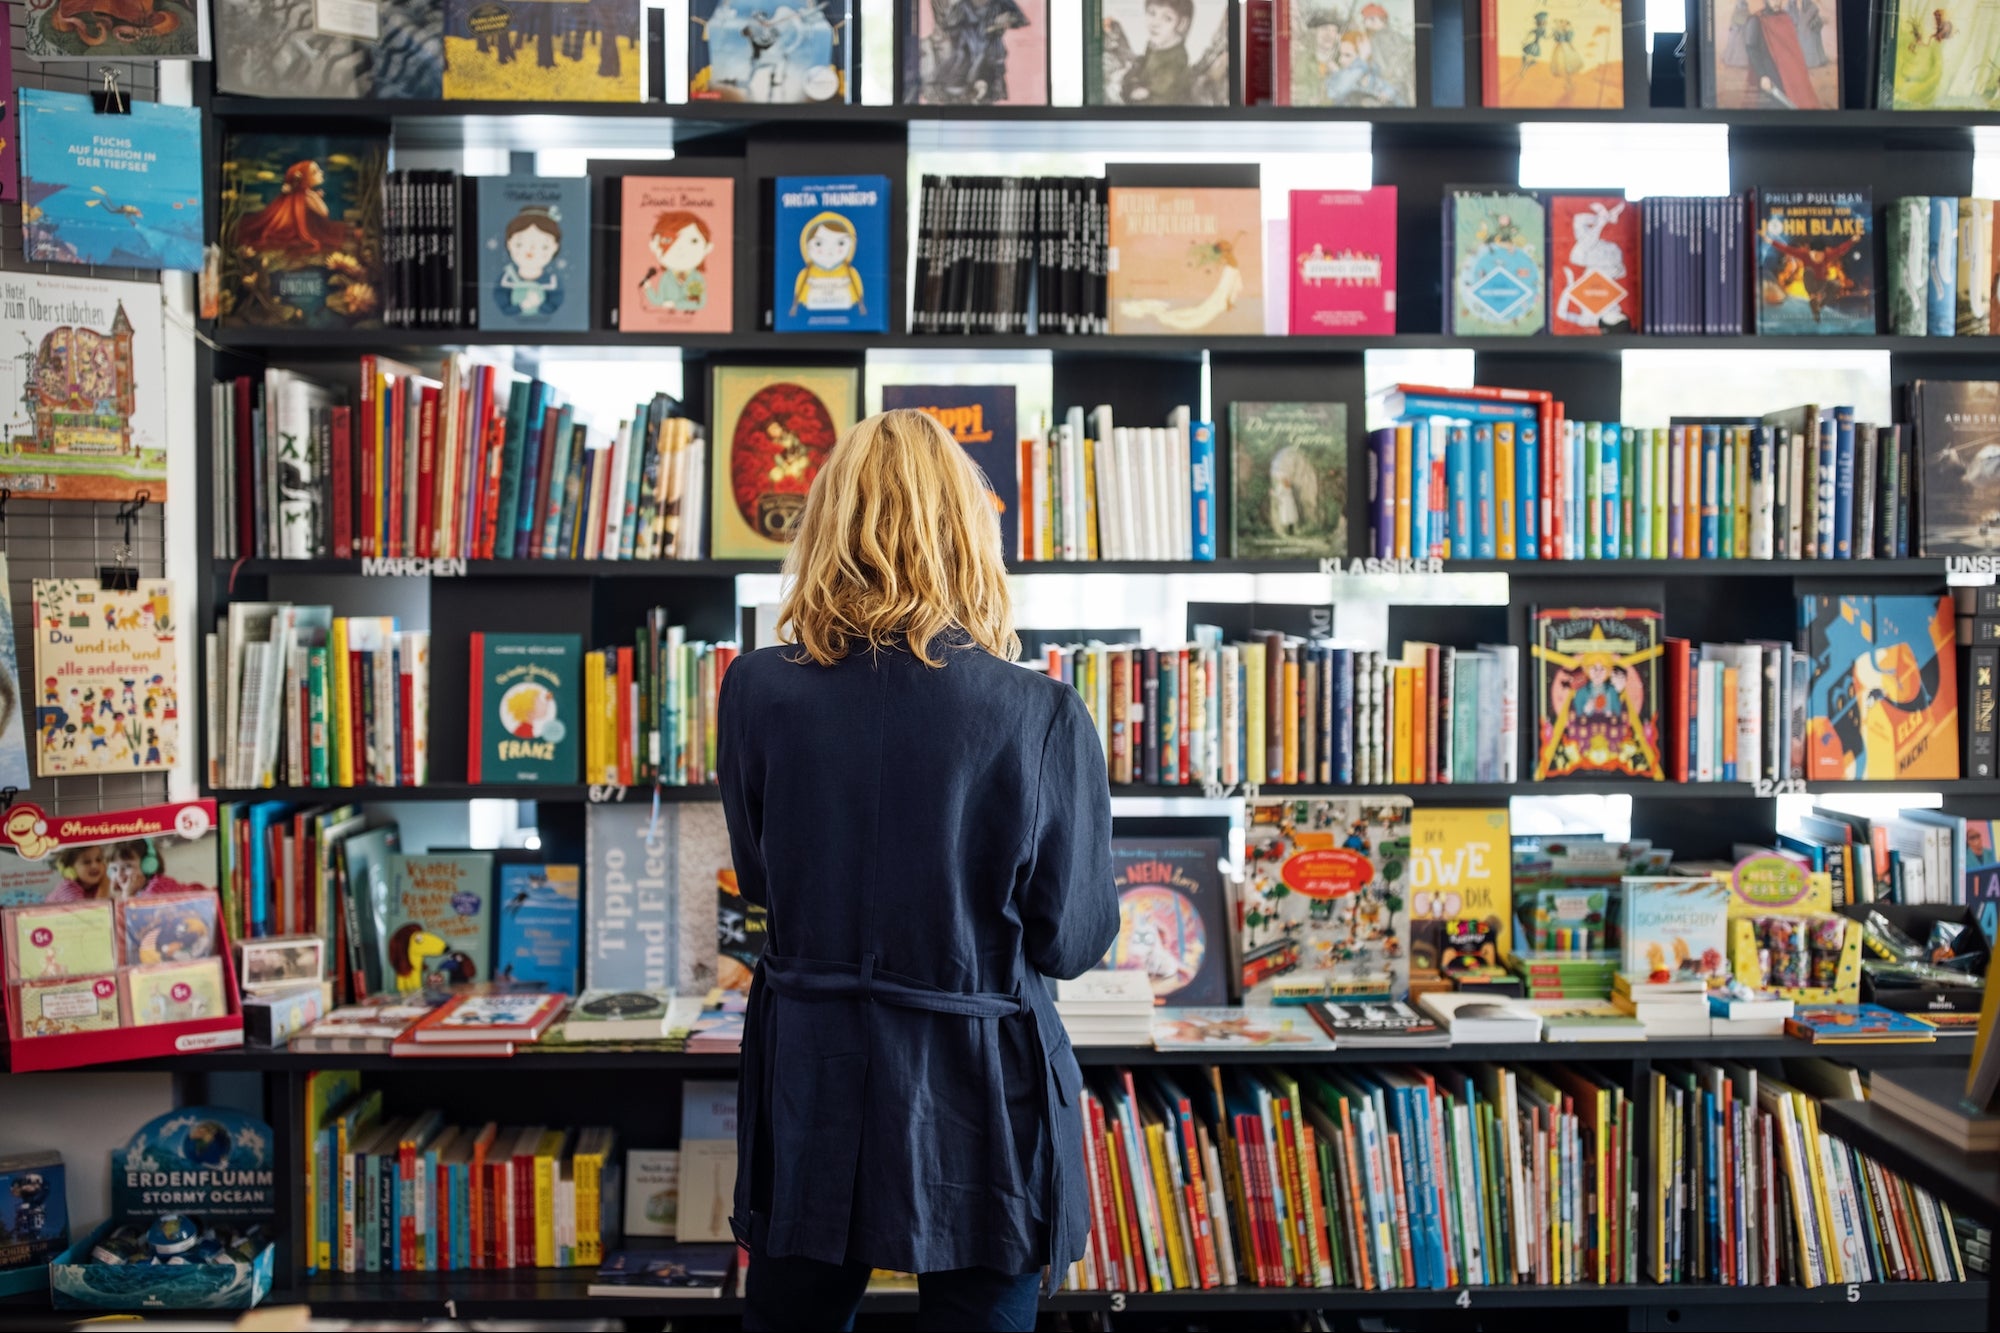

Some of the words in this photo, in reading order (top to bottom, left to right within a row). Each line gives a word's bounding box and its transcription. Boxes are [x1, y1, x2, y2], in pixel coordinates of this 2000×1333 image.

[93, 135, 132, 148] FUCHS
[68, 144, 91, 155] AUF
[93, 146, 142, 161] MISSION
[143, 151, 157, 162] IN
[77, 156, 101, 168] DER
[104, 159, 149, 173] TIEFSEE
[1765, 192, 1804, 204] PHILIP
[1807, 192, 1863, 204] PULLMAN
[1810, 218, 1866, 236] BLAKE
[4, 301, 25, 320] zum
[918, 403, 984, 434] ippi
[1319, 557, 1445, 576] KLASSIKER
[50, 630, 73, 644] Du
[75, 639, 104, 655] und
[108, 639, 131, 653] ich
[132, 647, 161, 661] und
[57, 661, 84, 676] alle
[87, 661, 148, 676] anderen
[498, 740, 555, 761] FRANZ
[1752, 779, 1807, 798] 12/13
[637, 815, 665, 912] Fleck
[1410, 841, 1491, 887] ÖWE
[598, 848, 633, 960] Tippo
[1638, 912, 1719, 927] SOMMERBY
[636, 921, 665, 989] und
[126, 1170, 273, 1188] ERDENFLUMM
[142, 1190, 207, 1204] STORMY
[210, 1189, 265, 1203] OCEAN
[1111, 1294, 1126, 1312] 3
[1455, 1290, 1472, 1309] 4
[1846, 1284, 1861, 1303] 5
[445, 1299, 457, 1318] 1
